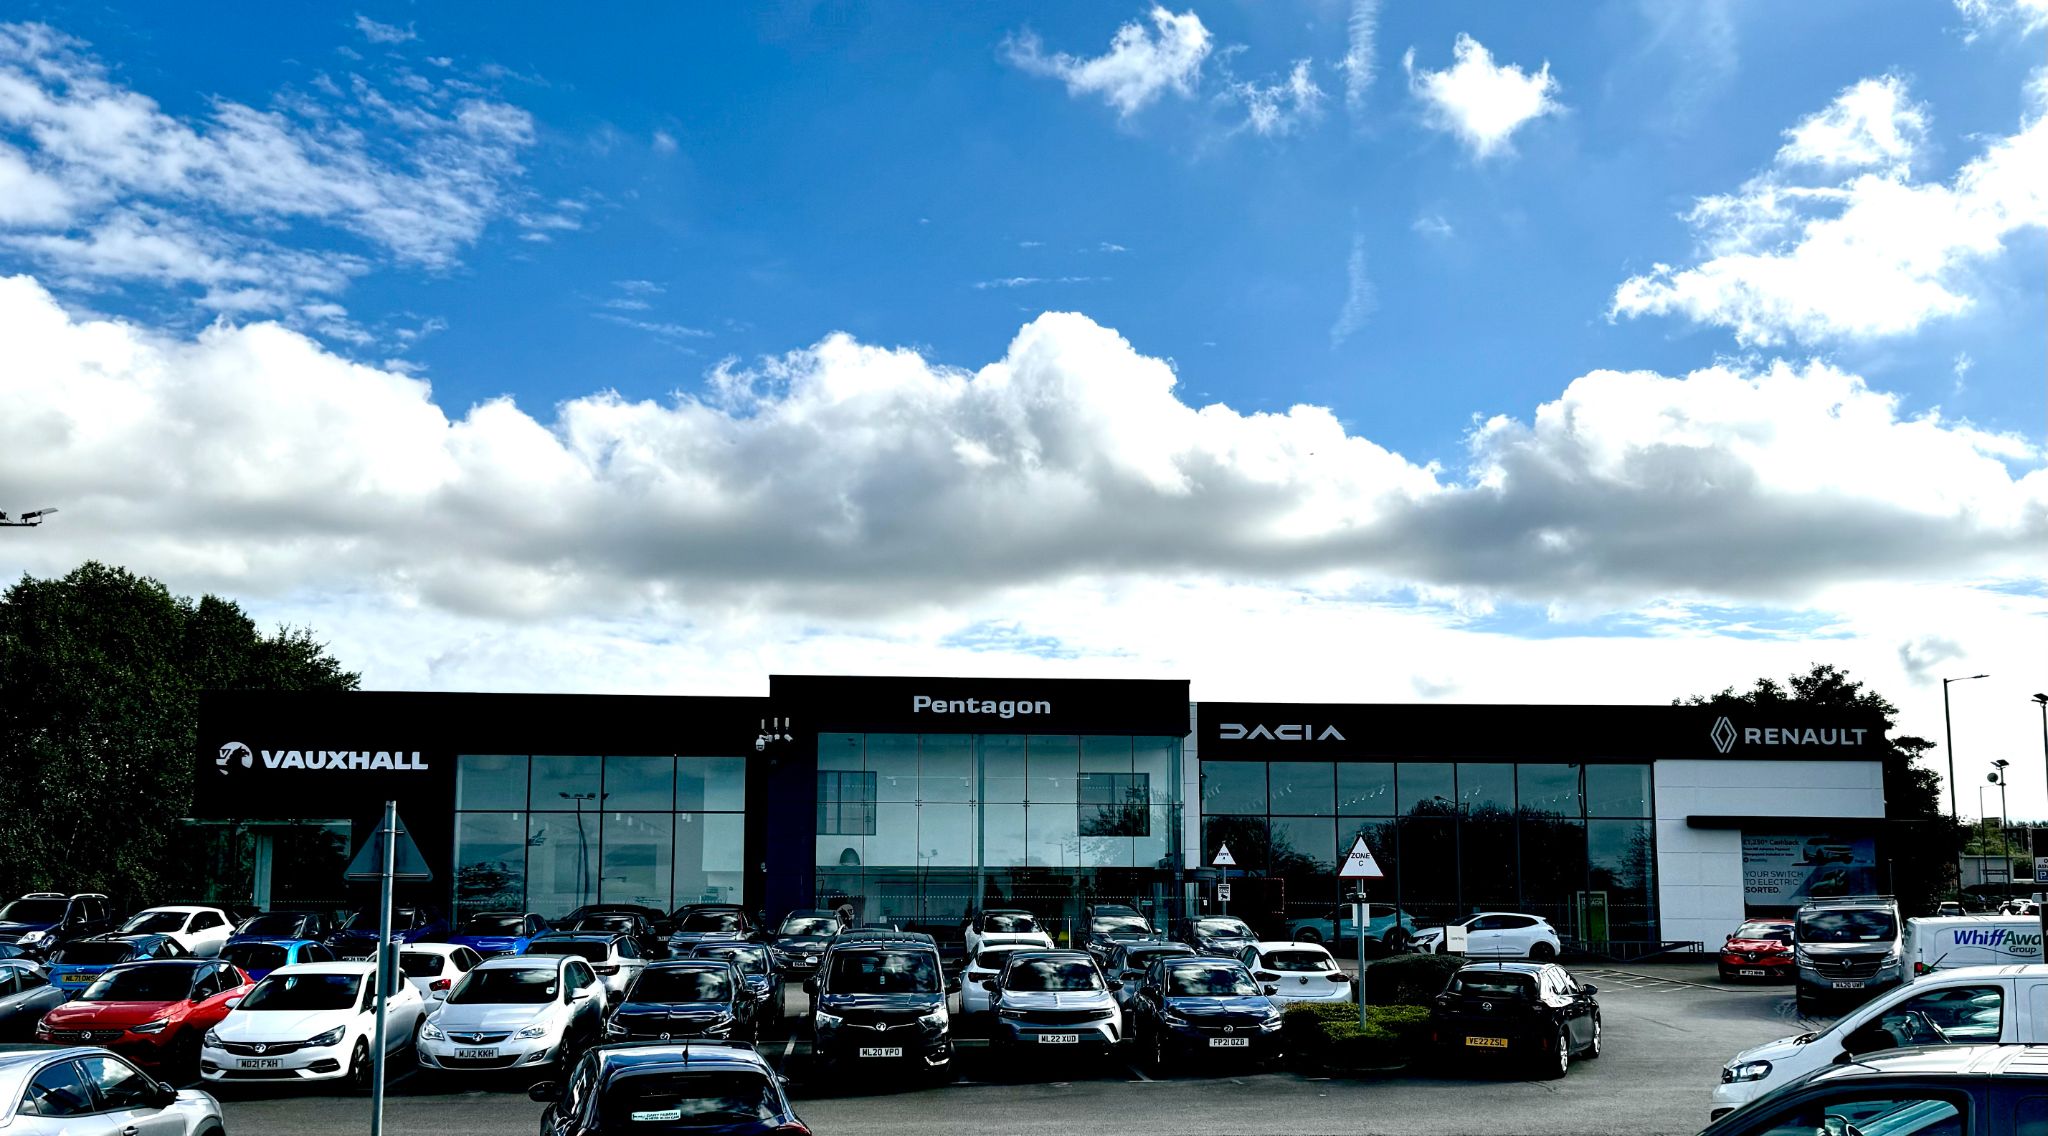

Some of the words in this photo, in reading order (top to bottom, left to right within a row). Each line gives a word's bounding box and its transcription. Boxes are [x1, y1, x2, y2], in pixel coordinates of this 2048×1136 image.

[913, 695, 1051, 719] Pentagon
[1220, 723, 1347, 741] DACIA
[1744, 727, 1868, 745] RENAULT
[261, 750, 429, 770] VAUXHALL
[1745, 870, 1769, 878] YOUR
[1770, 870, 1804, 878] SWITCH
[1745, 886, 1781, 894] SORTED.
[1954, 929, 2042, 946] WhiffAwa
[2008, 945, 2037, 954] Group
[260, 1059, 278, 1068] FXH
